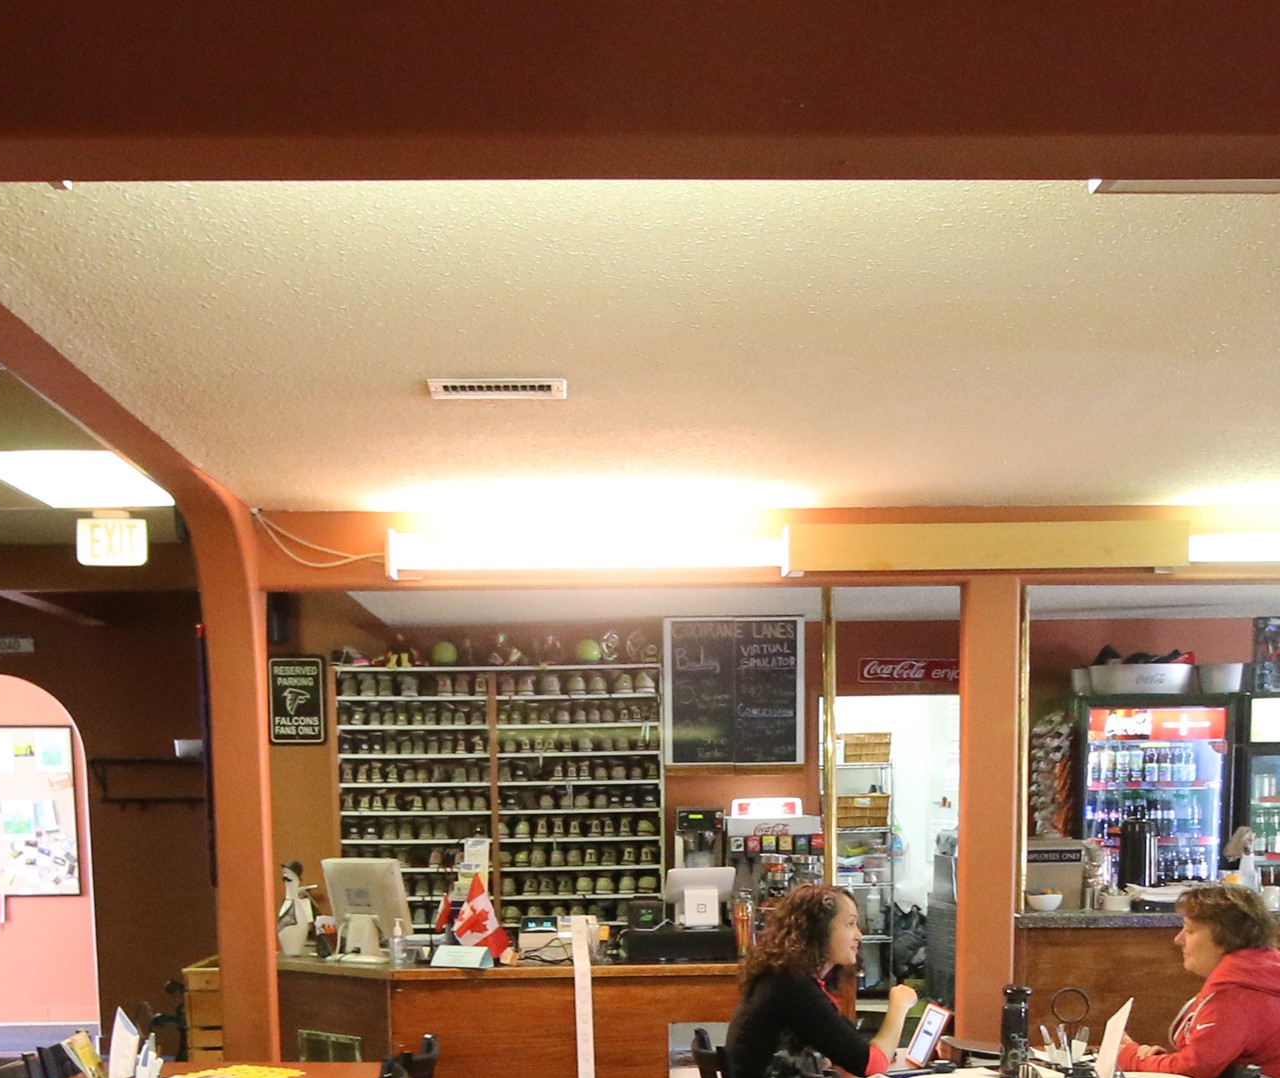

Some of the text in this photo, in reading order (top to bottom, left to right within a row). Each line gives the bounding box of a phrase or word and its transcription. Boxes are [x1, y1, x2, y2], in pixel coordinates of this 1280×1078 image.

[89, 523, 137, 559] EXIT
[752, 621, 796, 639] LANES
[740, 643, 791, 656] VIRTUAL
[273, 666, 317, 675] RESERVED
[277, 677, 314, 686] PARKING
[275, 717, 319, 725] FALCONS
[275, 726, 320, 735] FANS ONLY
